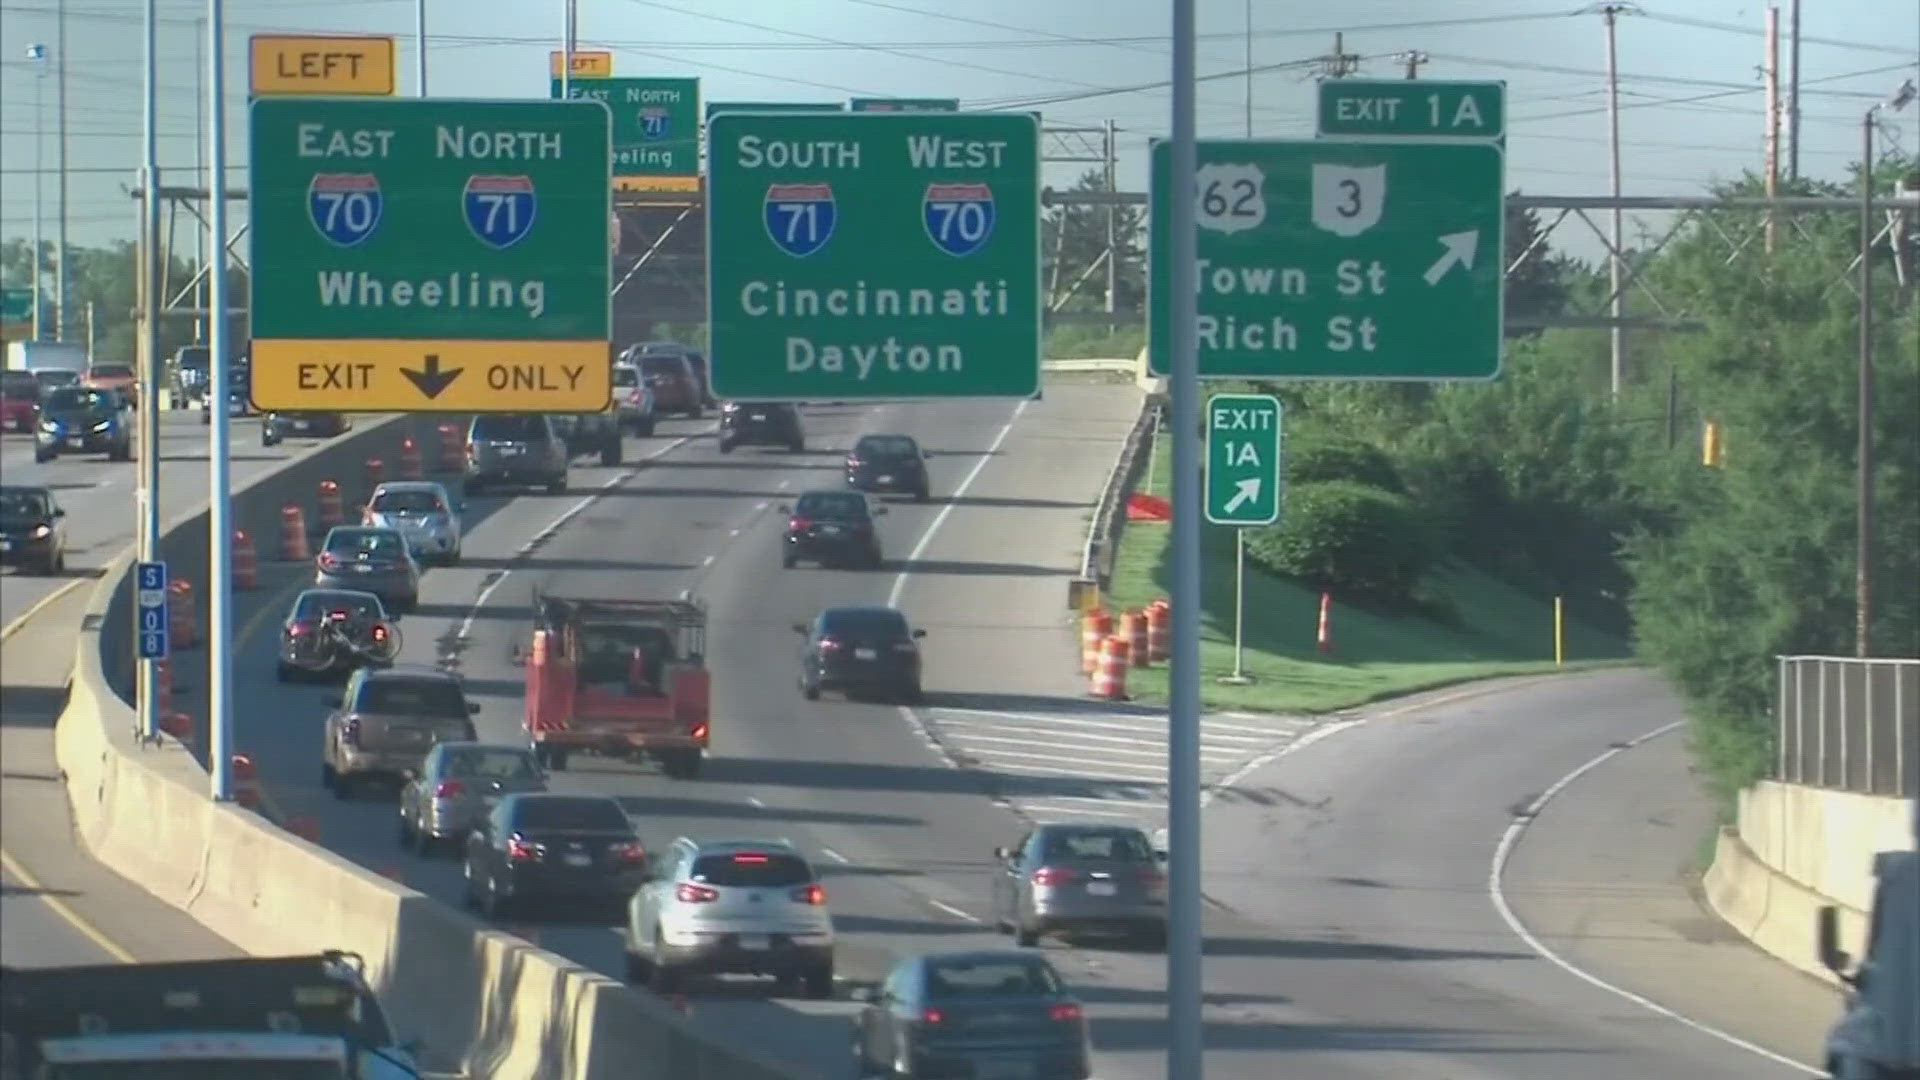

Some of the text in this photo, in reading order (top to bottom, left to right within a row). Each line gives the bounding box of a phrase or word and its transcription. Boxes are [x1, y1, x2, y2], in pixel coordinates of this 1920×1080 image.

[277, 51, 364, 80] LEFT
[570, 58, 598, 71] EFT
[626, 88, 681, 103] NORTH
[1336, 98, 1402, 121] EXIT
[298, 124, 562, 160] EAST NORTH
[738, 135, 1007, 169] SOUTH WEST
[317, 193, 517, 235] 70 71
[1202, 179, 1257, 217] 62
[1336, 179, 1361, 218] 3
[778, 203, 985, 243] 71 70
[318, 271, 545, 319] Wheeling
[1336, 259, 1386, 295] St
[741, 280, 1009, 316] Cincinnati
[1195, 315, 1377, 351] Rich St
[786, 336, 963, 381] Dayton
[298, 363, 585, 391] EXIT ONLY
[1214, 408, 1273, 431] EXIT
[1224, 441, 1261, 466] 1A
